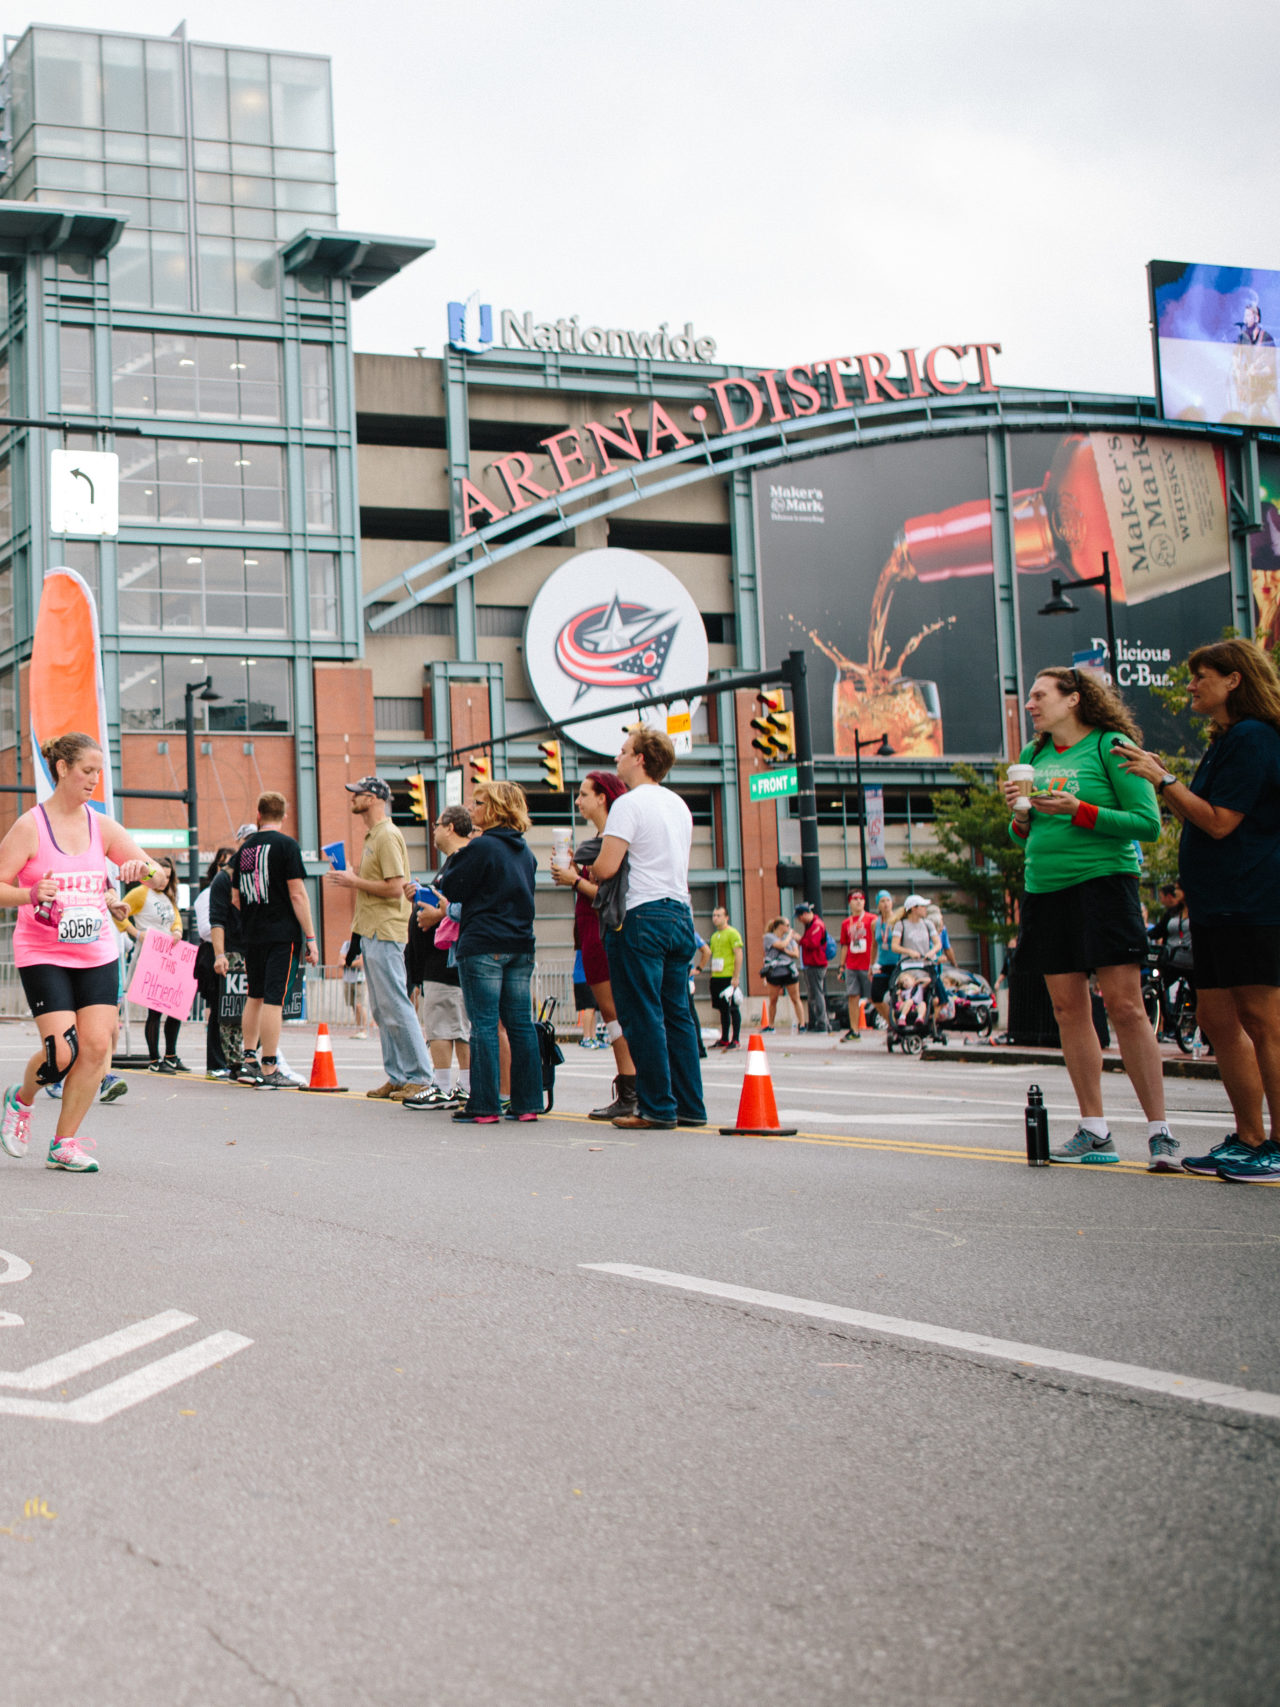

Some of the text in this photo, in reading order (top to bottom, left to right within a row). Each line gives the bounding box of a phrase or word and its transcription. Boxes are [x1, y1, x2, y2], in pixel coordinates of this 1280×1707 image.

[500, 308, 717, 362] Nationwide
[459, 342, 1002, 538] ARENA DISTRICT
[769, 484, 823, 499] Maker's
[1162, 448, 1191, 543] WHISKY
[1108, 435, 1150, 574] Maker's
[1091, 637, 1171, 661] Dlicious
[758, 775, 788, 794] FRONT
[60, 917, 93, 939] 3056
[180, 946, 197, 962] GOT
[160, 957, 178, 975] THIS
